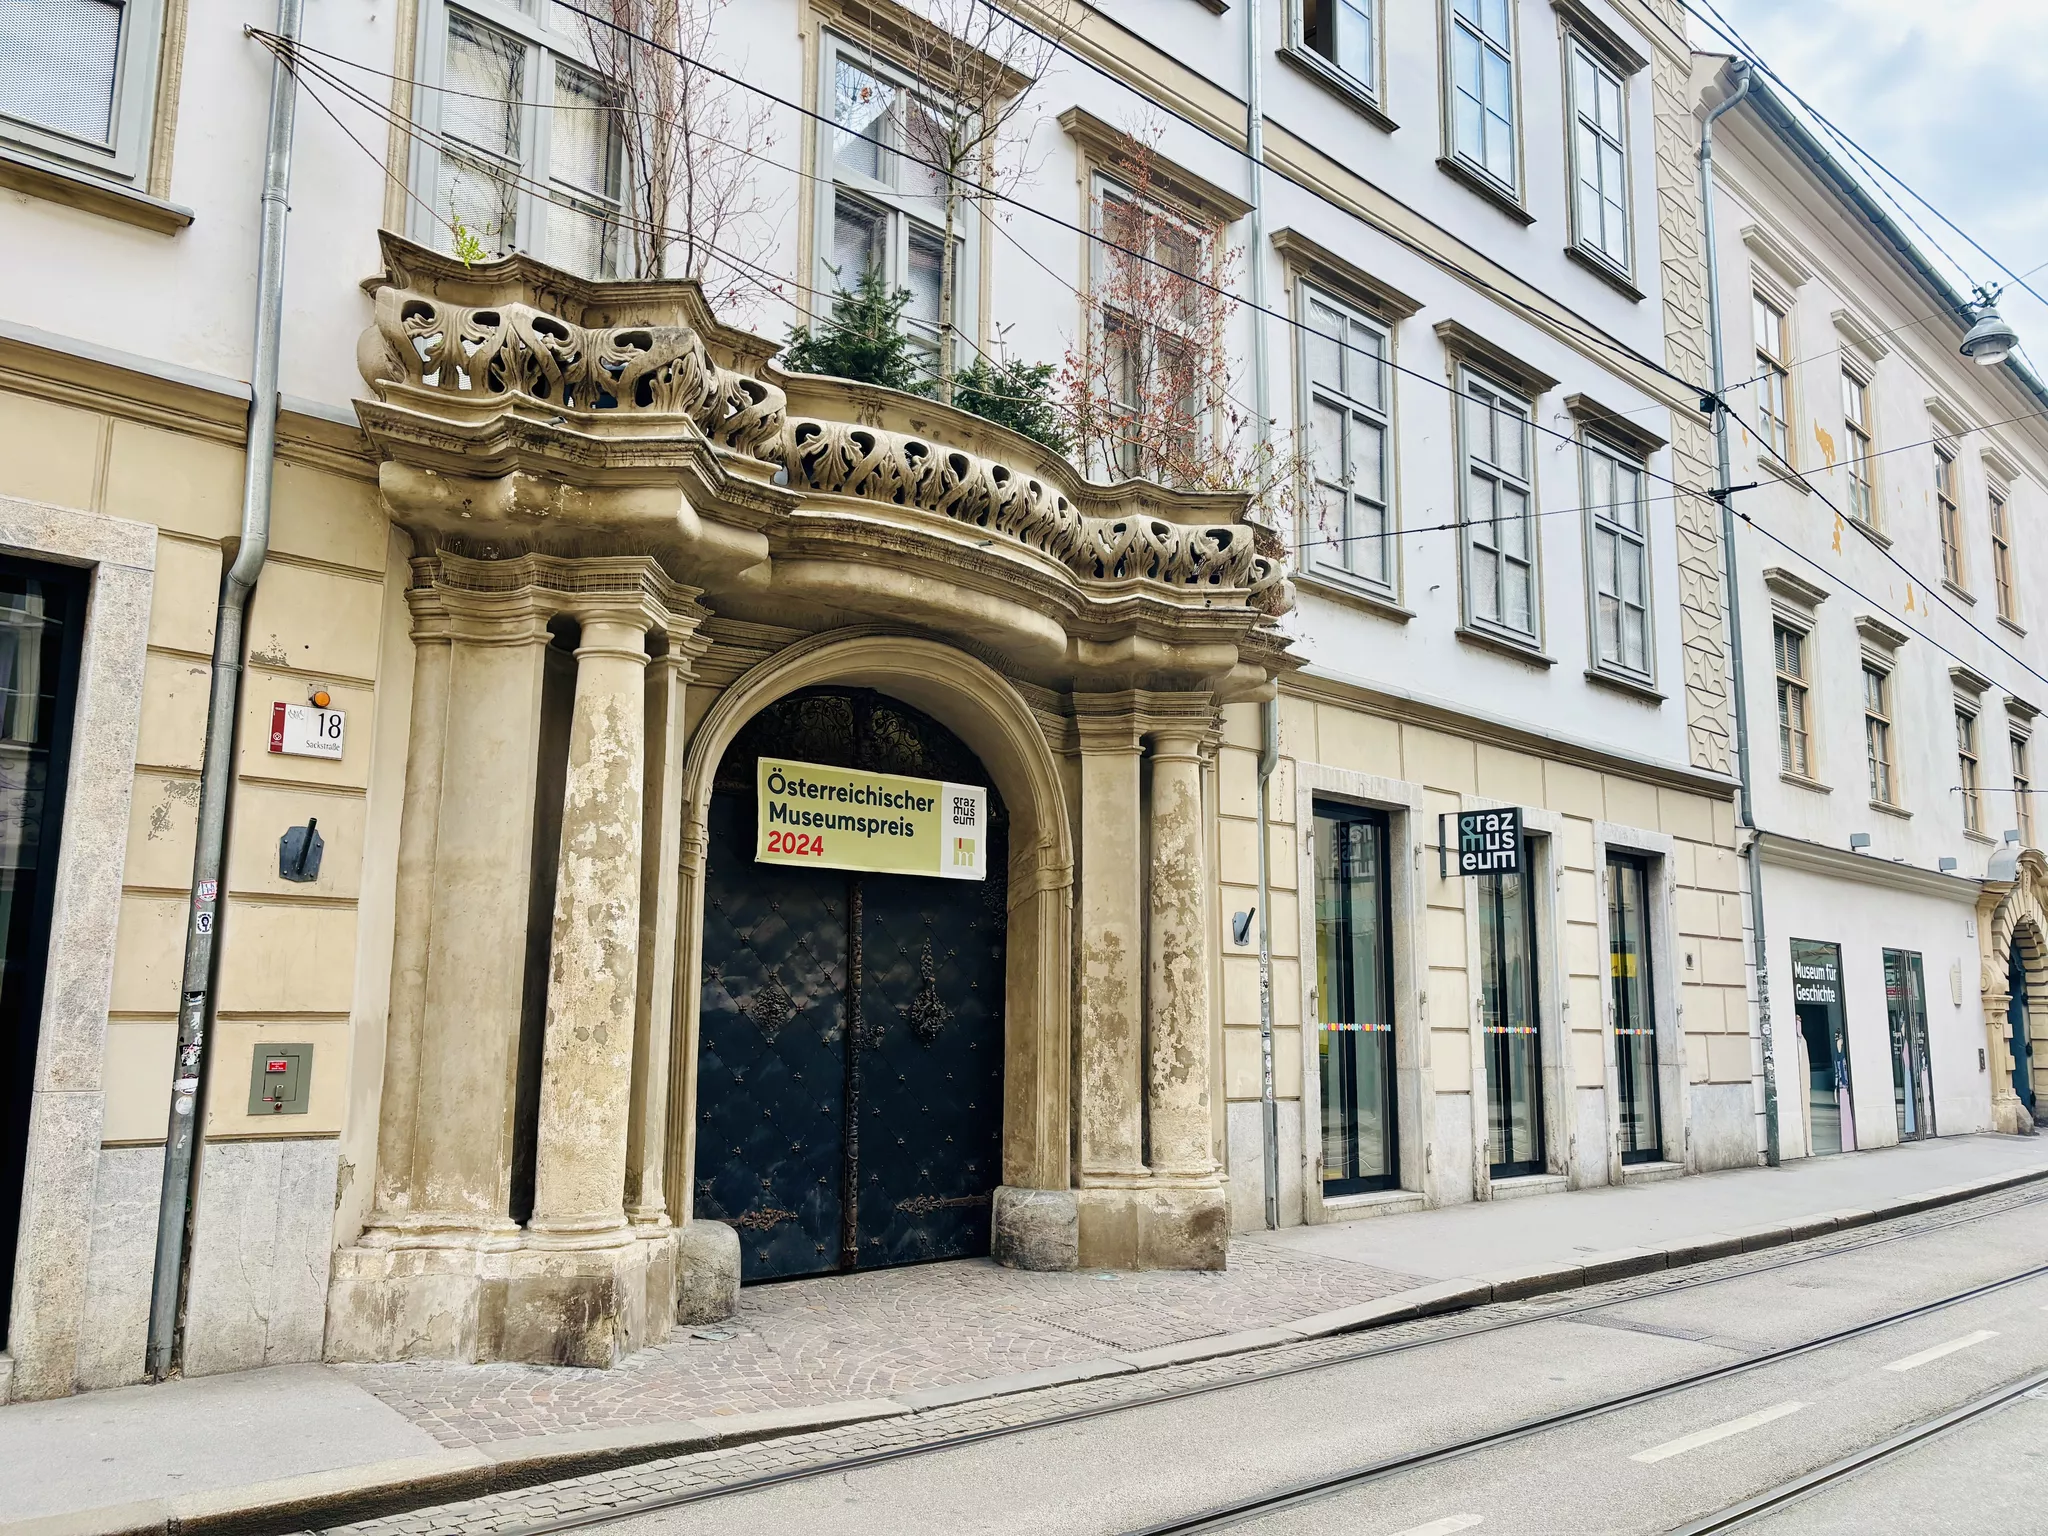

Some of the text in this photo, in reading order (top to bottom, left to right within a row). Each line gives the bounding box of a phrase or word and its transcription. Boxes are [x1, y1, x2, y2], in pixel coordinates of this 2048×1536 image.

[318, 712, 342, 739] 18
[306, 740, 340, 751] Sackstraße
[767, 767, 935, 812] Österreichischer
[953, 797, 975, 807] graz
[953, 806, 975, 817] mus
[769, 801, 914, 838] Museumspreis
[953, 815, 975, 826] eum
[1460, 812, 1514, 835] graz
[767, 830, 824, 857] 2024
[1462, 831, 1515, 852] mus
[1462, 850, 1516, 871] eum
[1794, 961, 1837, 981] Museum für
[1796, 983, 1836, 1003] Geschichte
